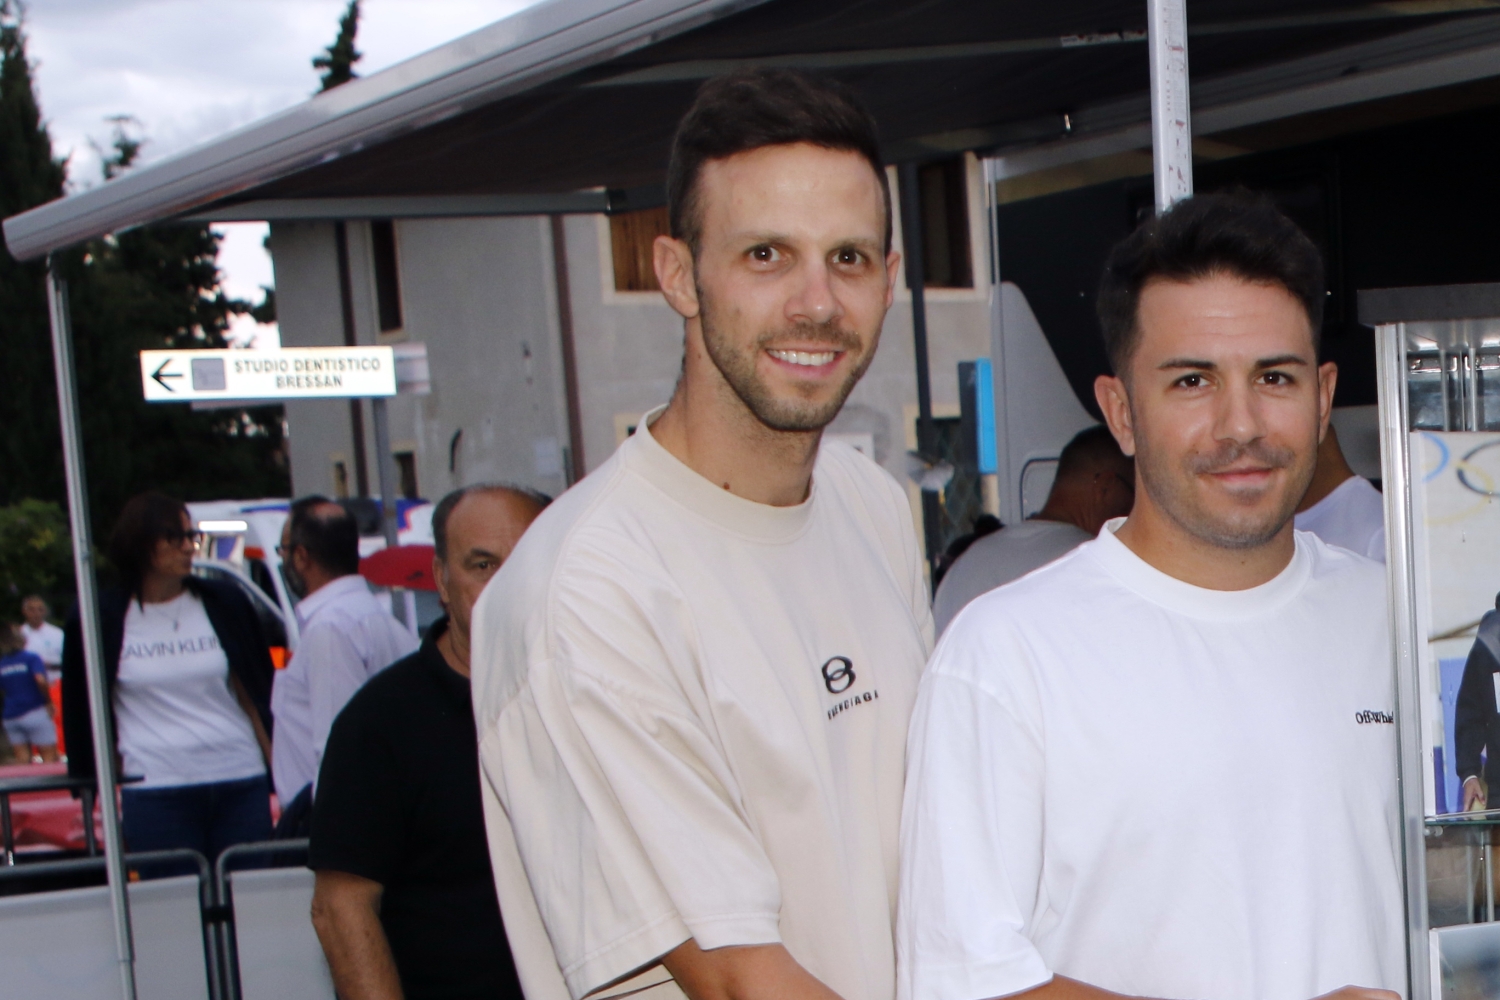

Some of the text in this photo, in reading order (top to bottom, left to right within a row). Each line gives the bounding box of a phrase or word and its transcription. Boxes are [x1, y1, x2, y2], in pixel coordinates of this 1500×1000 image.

[234, 357, 381, 373] STUDIO DENTISTICO
[276, 374, 342, 389] BRESSAN
[121, 642, 175, 659] ALVIN
